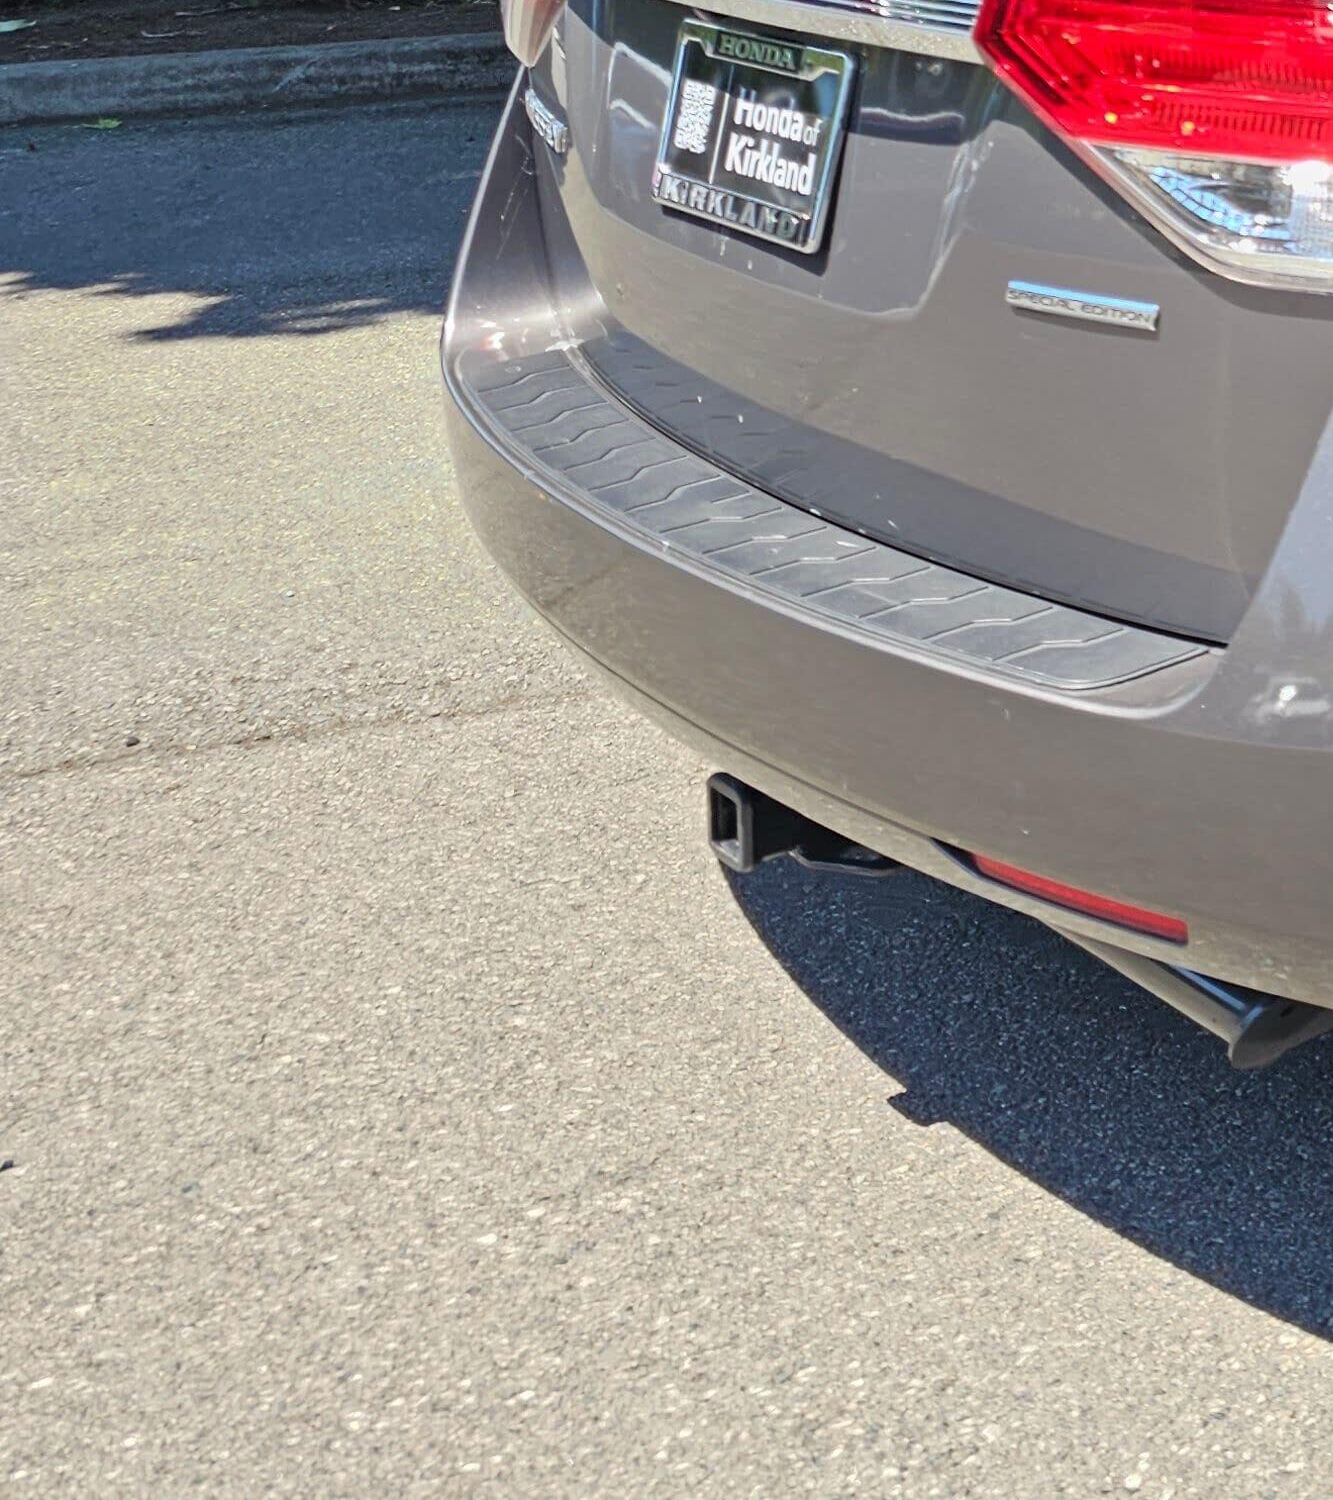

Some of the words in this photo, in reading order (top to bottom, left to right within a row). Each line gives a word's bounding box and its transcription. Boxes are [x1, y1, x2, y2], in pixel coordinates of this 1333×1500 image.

[719, 36, 796, 69] HONDA
[733, 86, 803, 142] Honda
[803, 118, 823, 146] of
[724, 132, 817, 196] Kirkland
[1007, 290, 1075, 311] SPECIAL
[1081, 304, 1151, 323] EDITION
